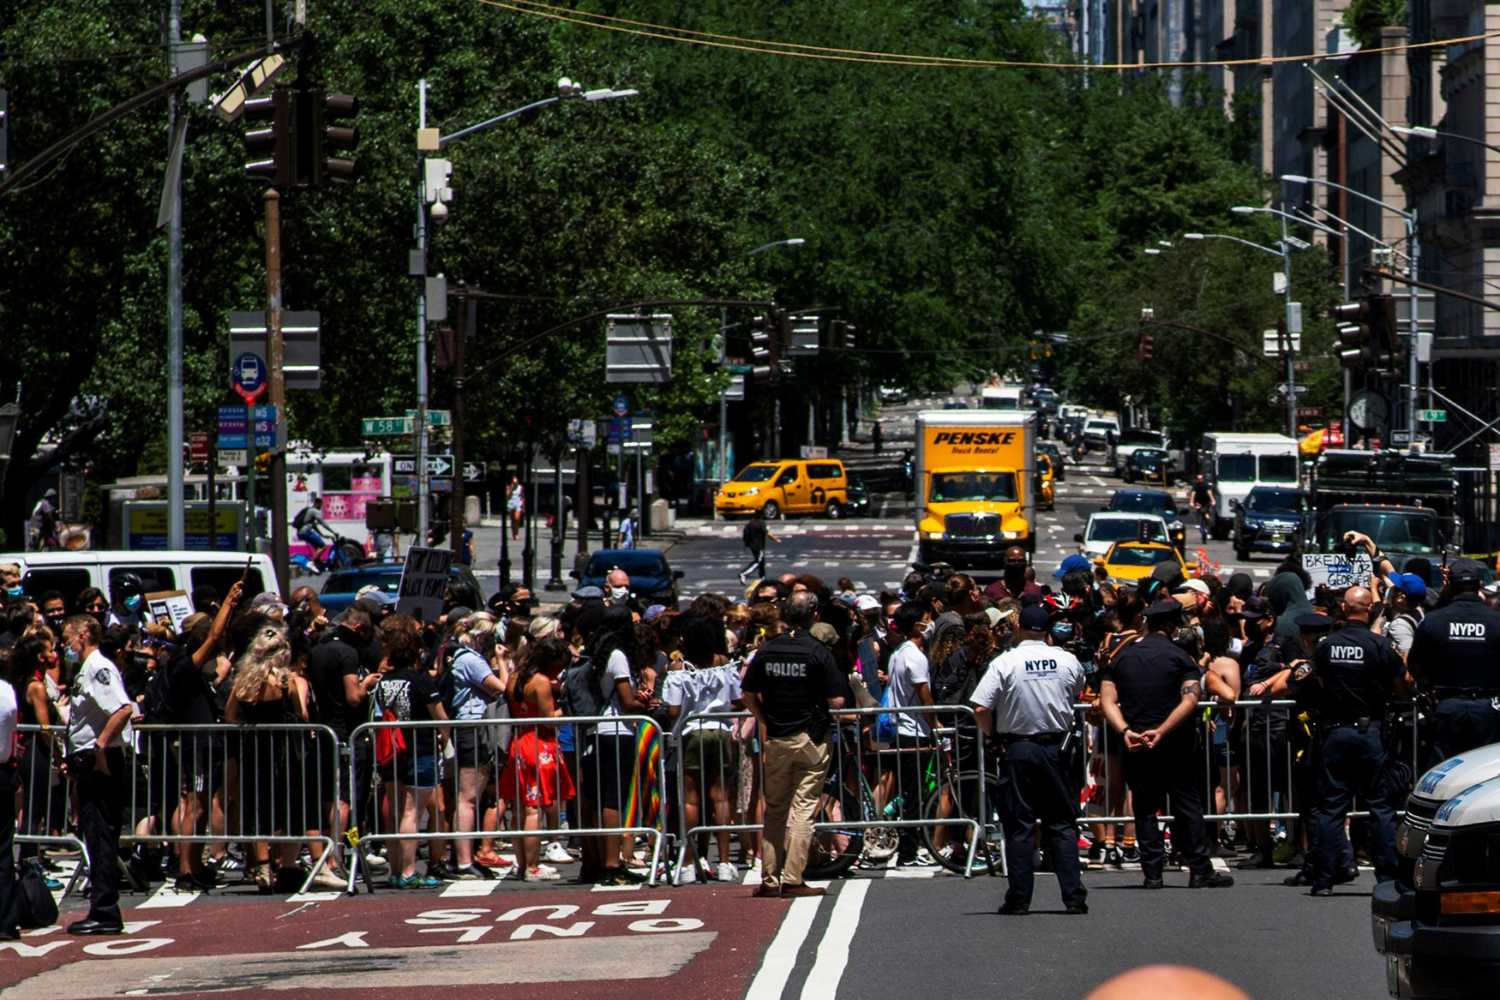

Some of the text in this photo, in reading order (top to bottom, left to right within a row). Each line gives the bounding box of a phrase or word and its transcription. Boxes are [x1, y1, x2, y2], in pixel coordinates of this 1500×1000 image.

[379, 420, 393, 432] 58
[933, 432, 1017, 445] PENSKE
[1449, 622, 1485, 636] NYPD
[1330, 645, 1364, 659] NYPD
[765, 662, 807, 677] POLICE
[1025, 659, 1057, 672] NYPD
